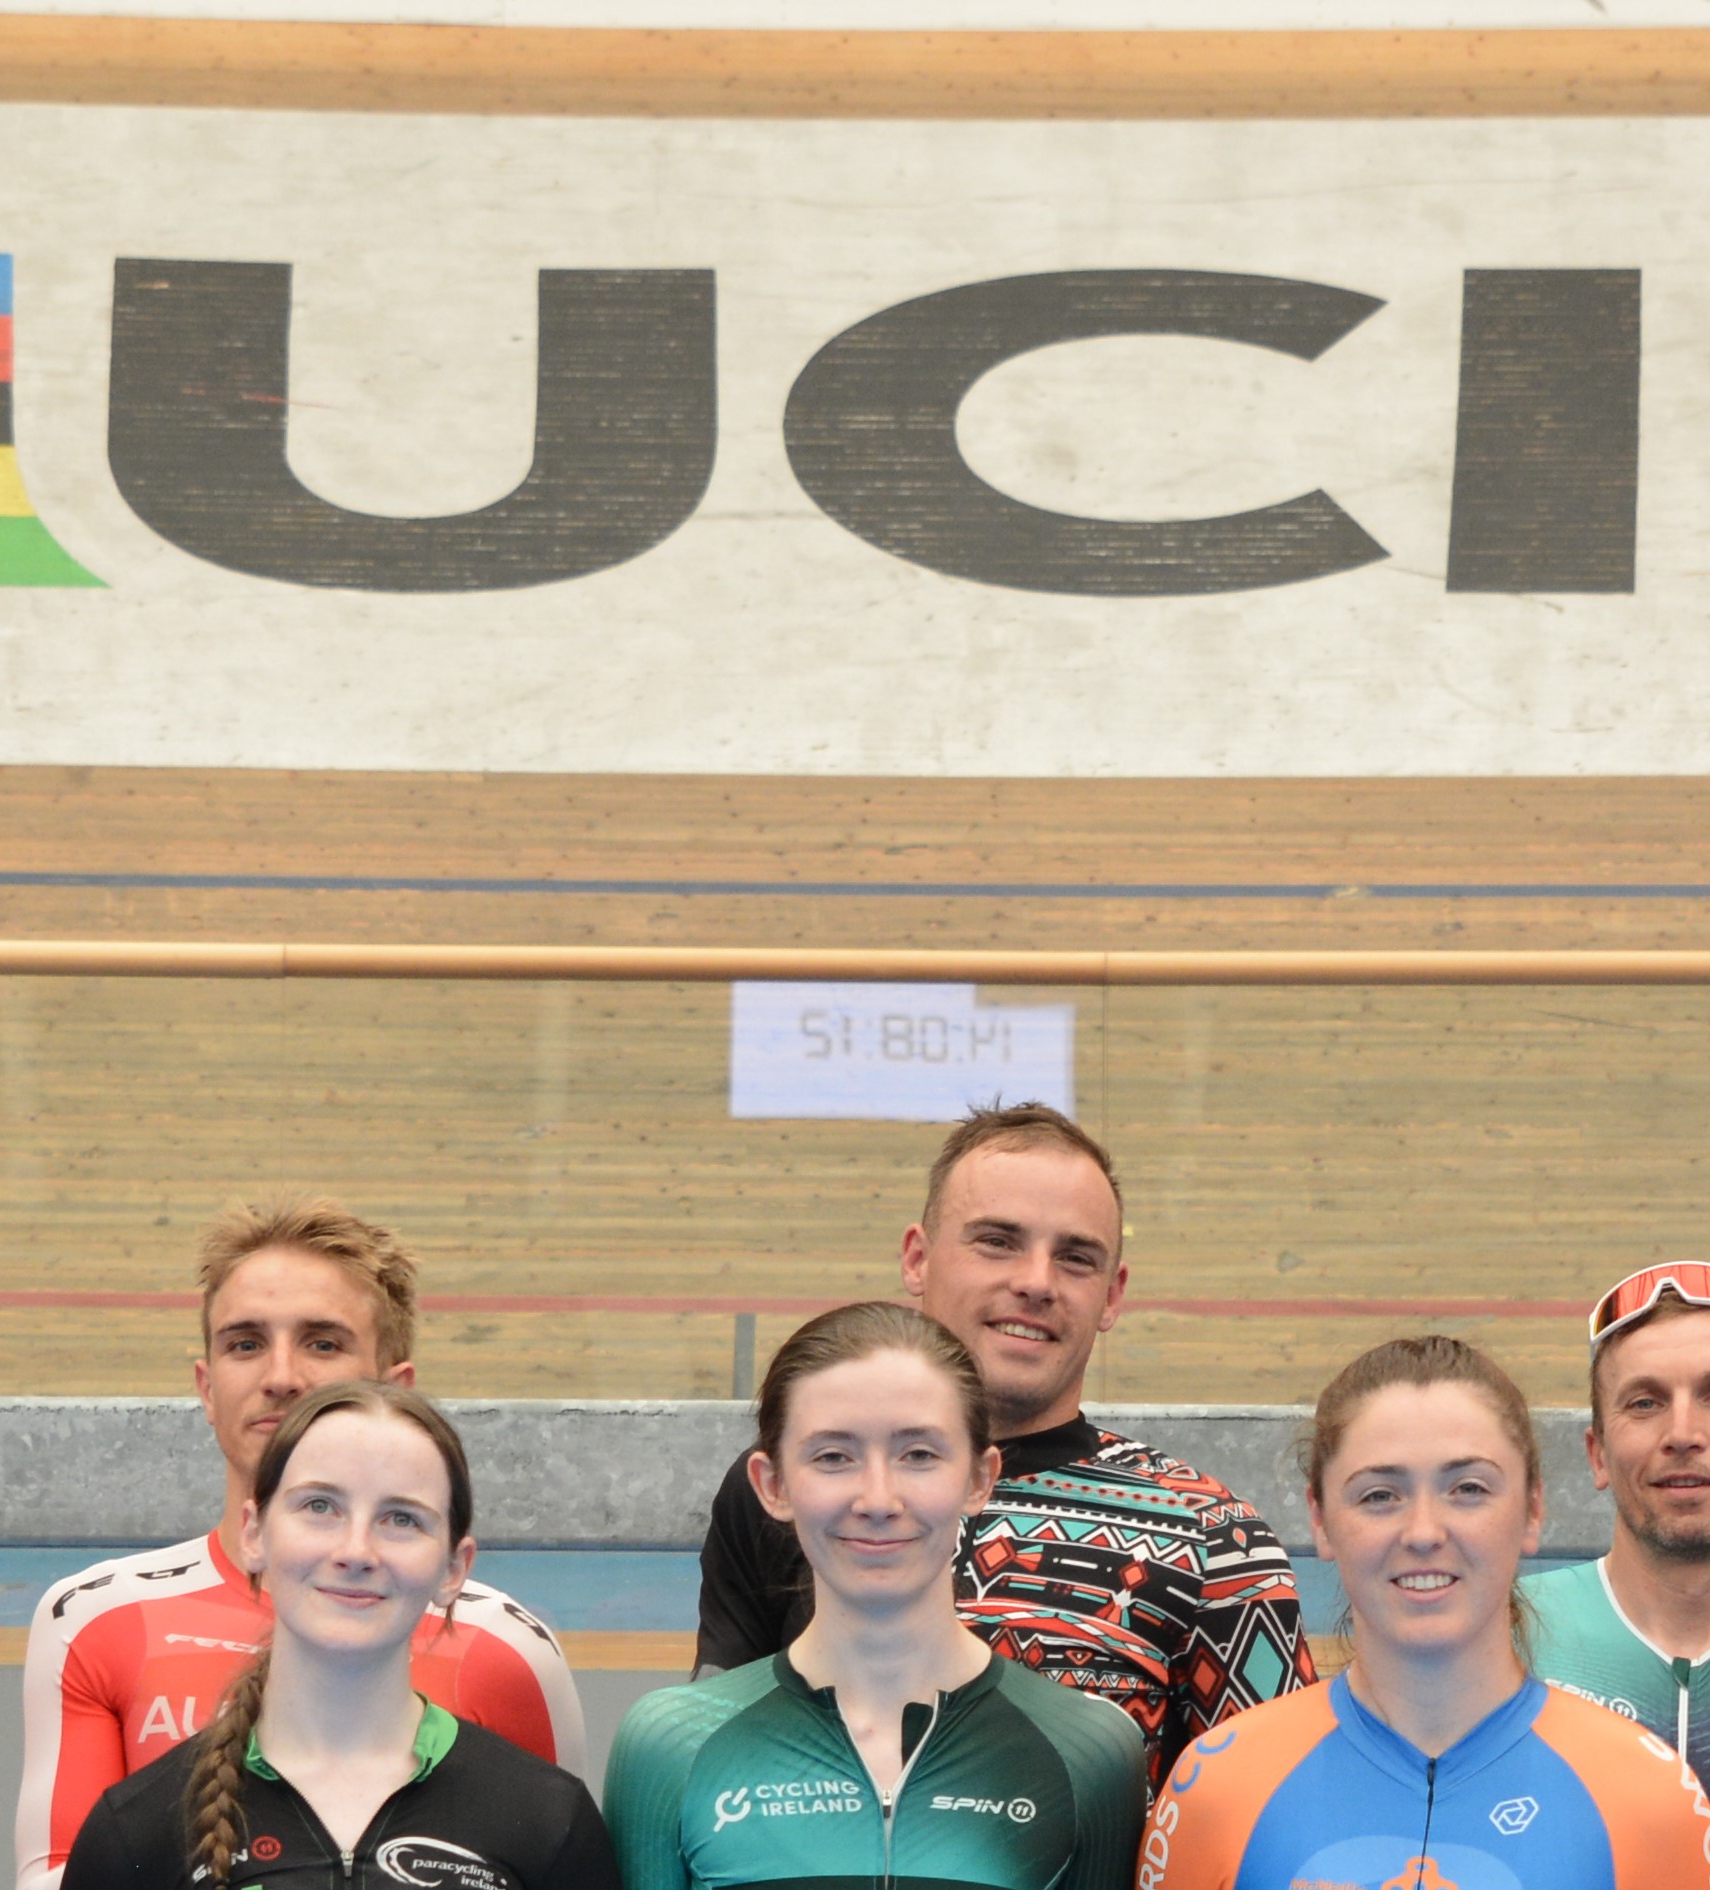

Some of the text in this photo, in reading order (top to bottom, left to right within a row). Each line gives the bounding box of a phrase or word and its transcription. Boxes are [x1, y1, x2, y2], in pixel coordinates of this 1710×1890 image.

[107, 256, 1642, 597] UCI
[755, 1779, 861, 1799] CYCLING
[761, 1798, 863, 1817] IRELAND
[411, 1857, 495, 1883] paracycling
